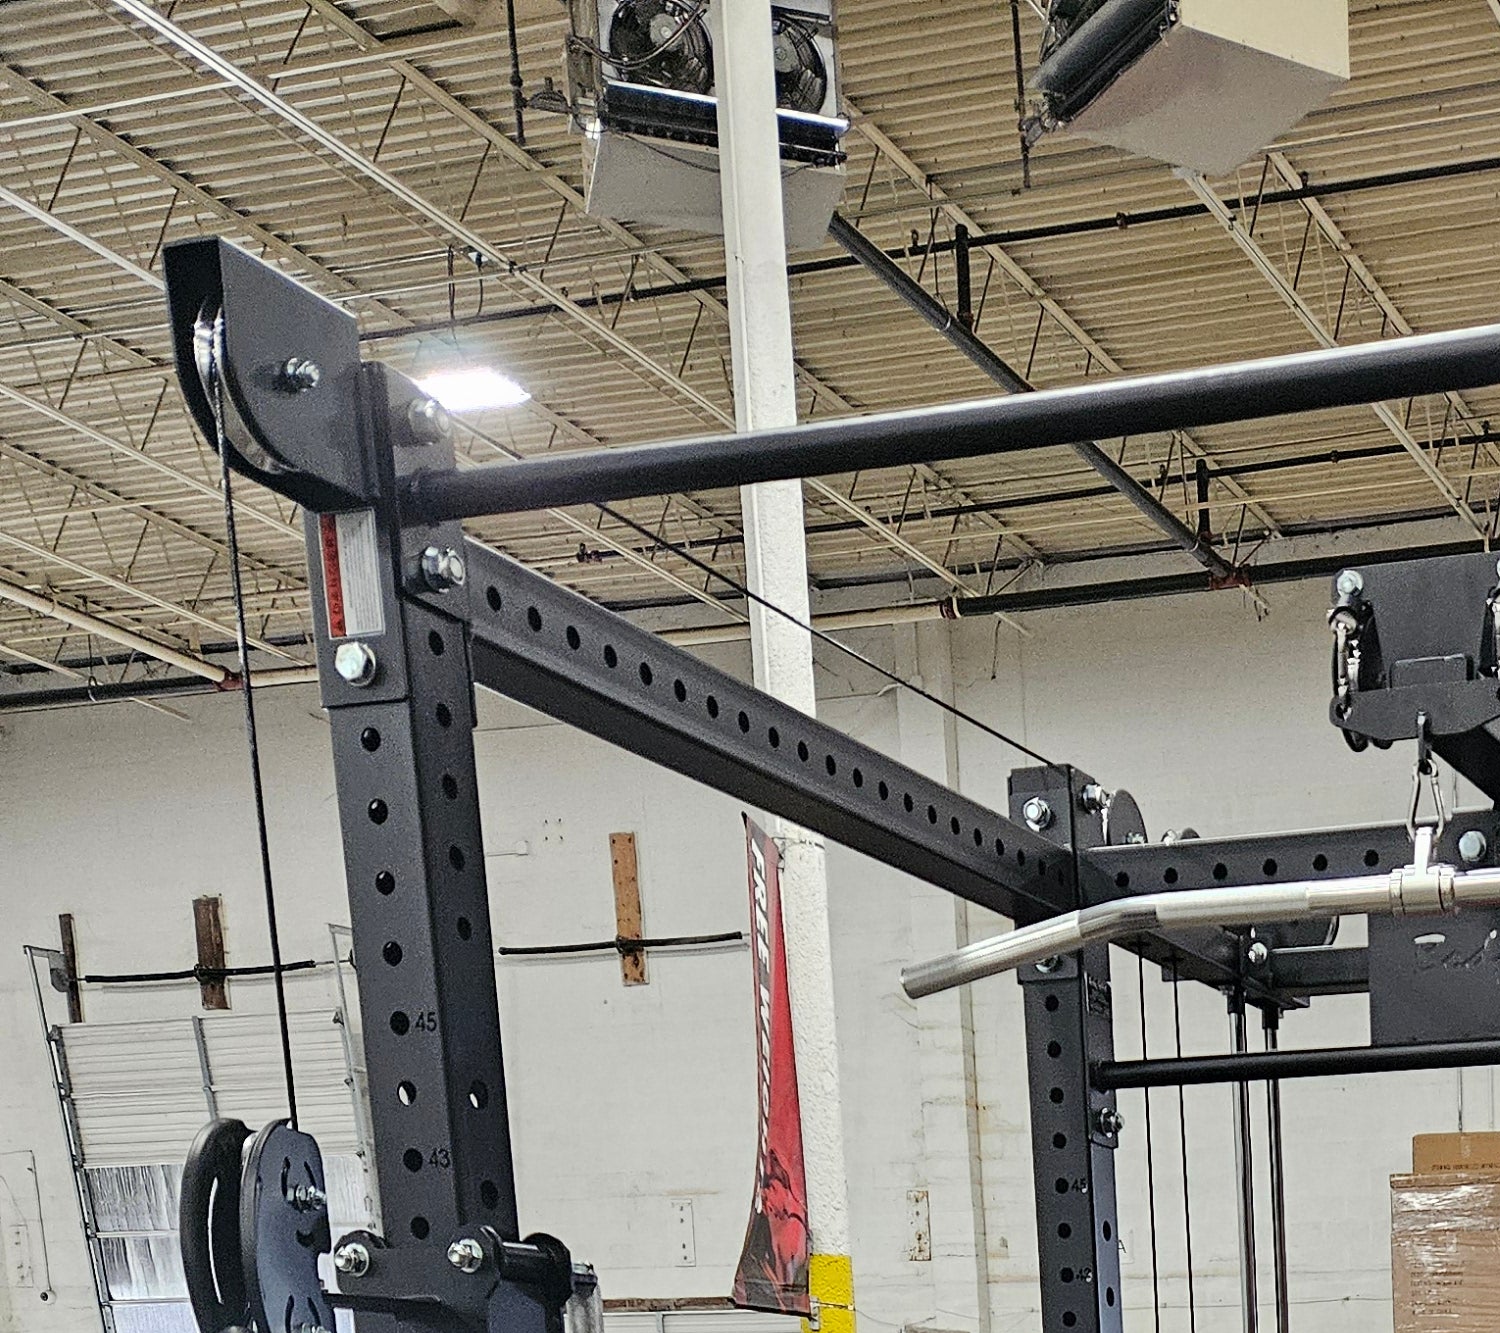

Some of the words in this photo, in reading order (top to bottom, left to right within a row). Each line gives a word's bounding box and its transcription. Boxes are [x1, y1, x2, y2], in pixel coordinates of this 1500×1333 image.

[751, 836, 770, 973] FREE
[415, 1012, 437, 1032] 45
[429, 1148, 450, 1168] 43
